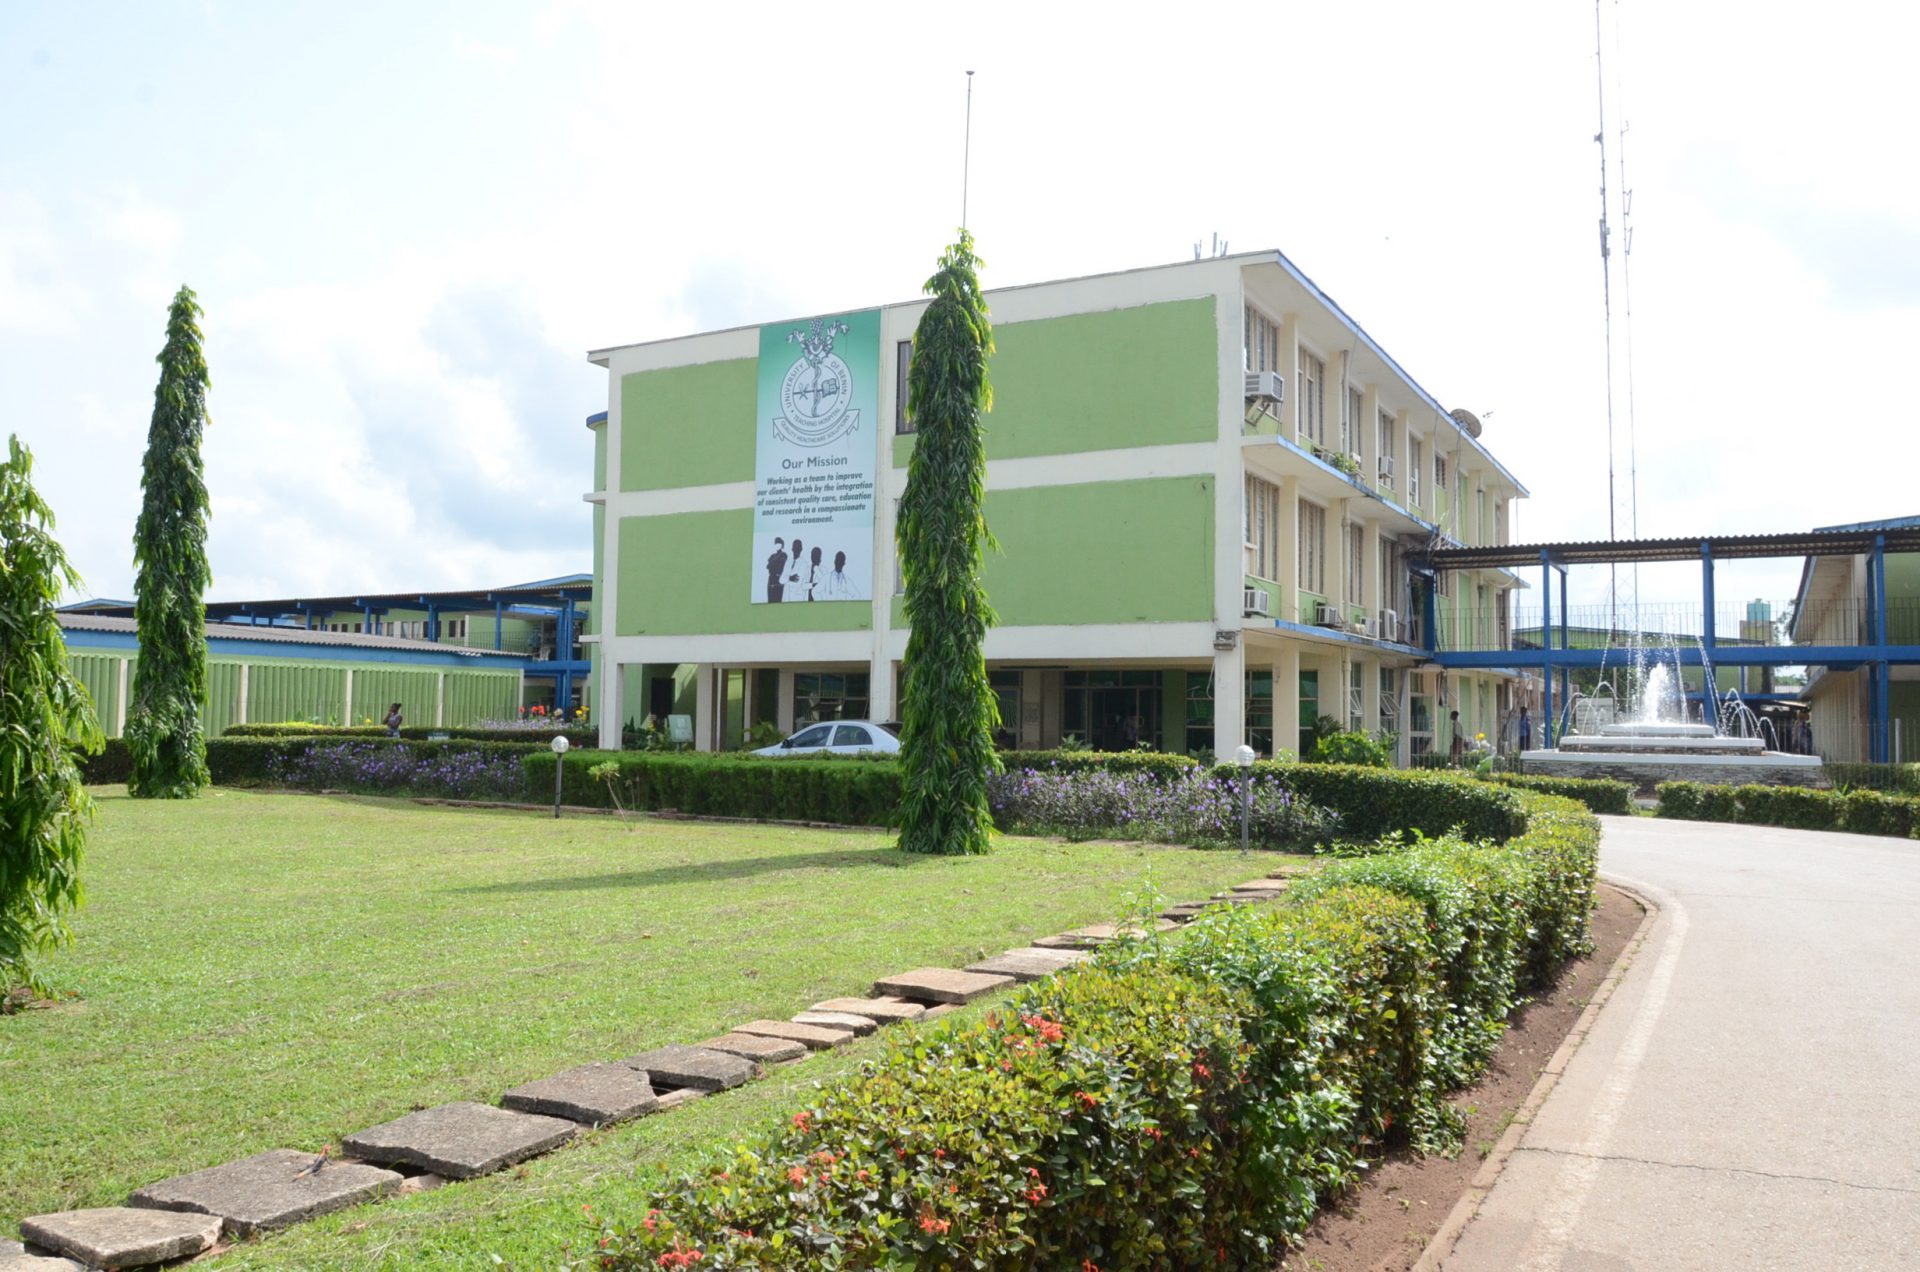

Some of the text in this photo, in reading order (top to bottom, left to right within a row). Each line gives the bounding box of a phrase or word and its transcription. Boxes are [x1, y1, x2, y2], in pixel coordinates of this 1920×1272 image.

[784, 361, 847, 408] UNIVERSITY OF BENIN
[793, 408, 841, 426] TEACHING HOSPITAL
[781, 420, 797, 439] QUALITY
[782, 456, 848, 470] Our Mission
[767, 478, 792, 486] Working
[836, 473, 863, 482] improve
[792, 485, 812, 493] health
[814, 484, 822, 493] by
[836, 482, 873, 492] integration
[758, 498, 764, 506] of
[766, 497, 796, 506] consistent
[798, 495, 820, 505] quality
[839, 492, 871, 501] education
[762, 508, 774, 516] and
[776, 506, 802, 515] research
[818, 503, 866, 514] compassionate
[792, 515, 834, 524] environment.
